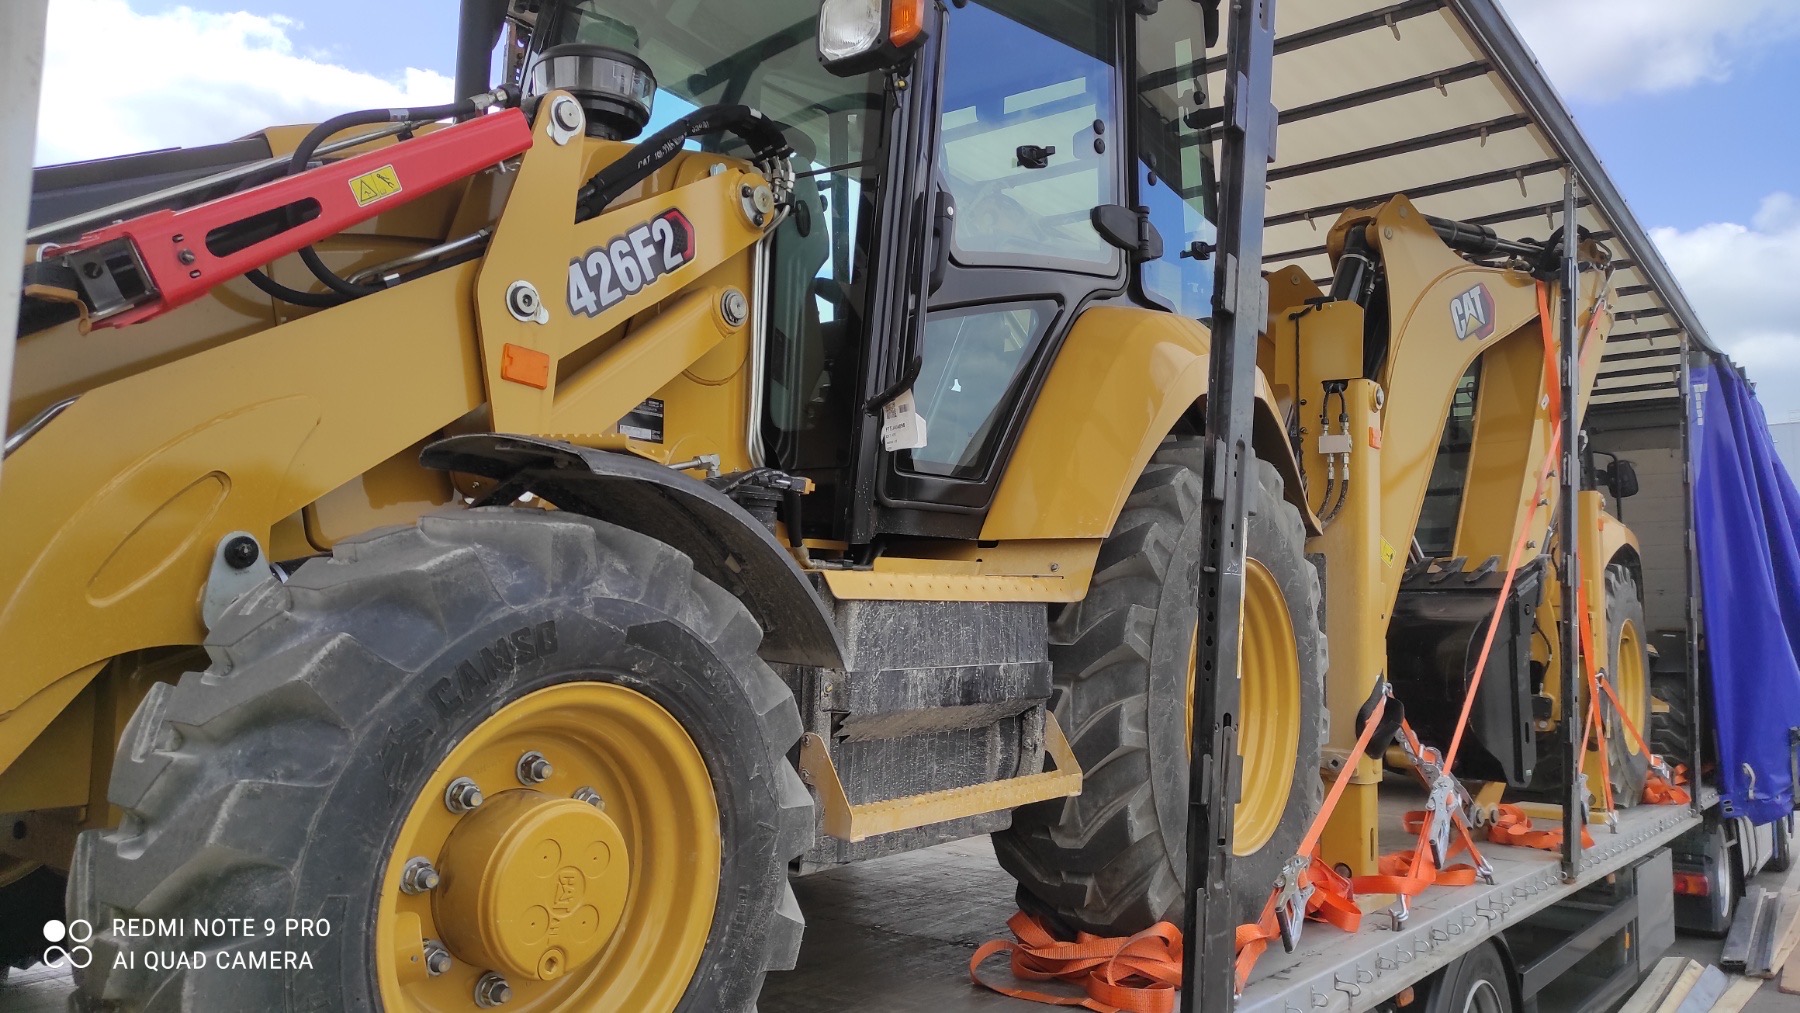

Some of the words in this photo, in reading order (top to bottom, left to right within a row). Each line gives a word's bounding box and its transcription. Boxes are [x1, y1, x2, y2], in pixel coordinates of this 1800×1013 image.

[568, 217, 684, 314] 426F2
[1450, 285, 1486, 339] CAT
[427, 620, 558, 720] CAMSO
